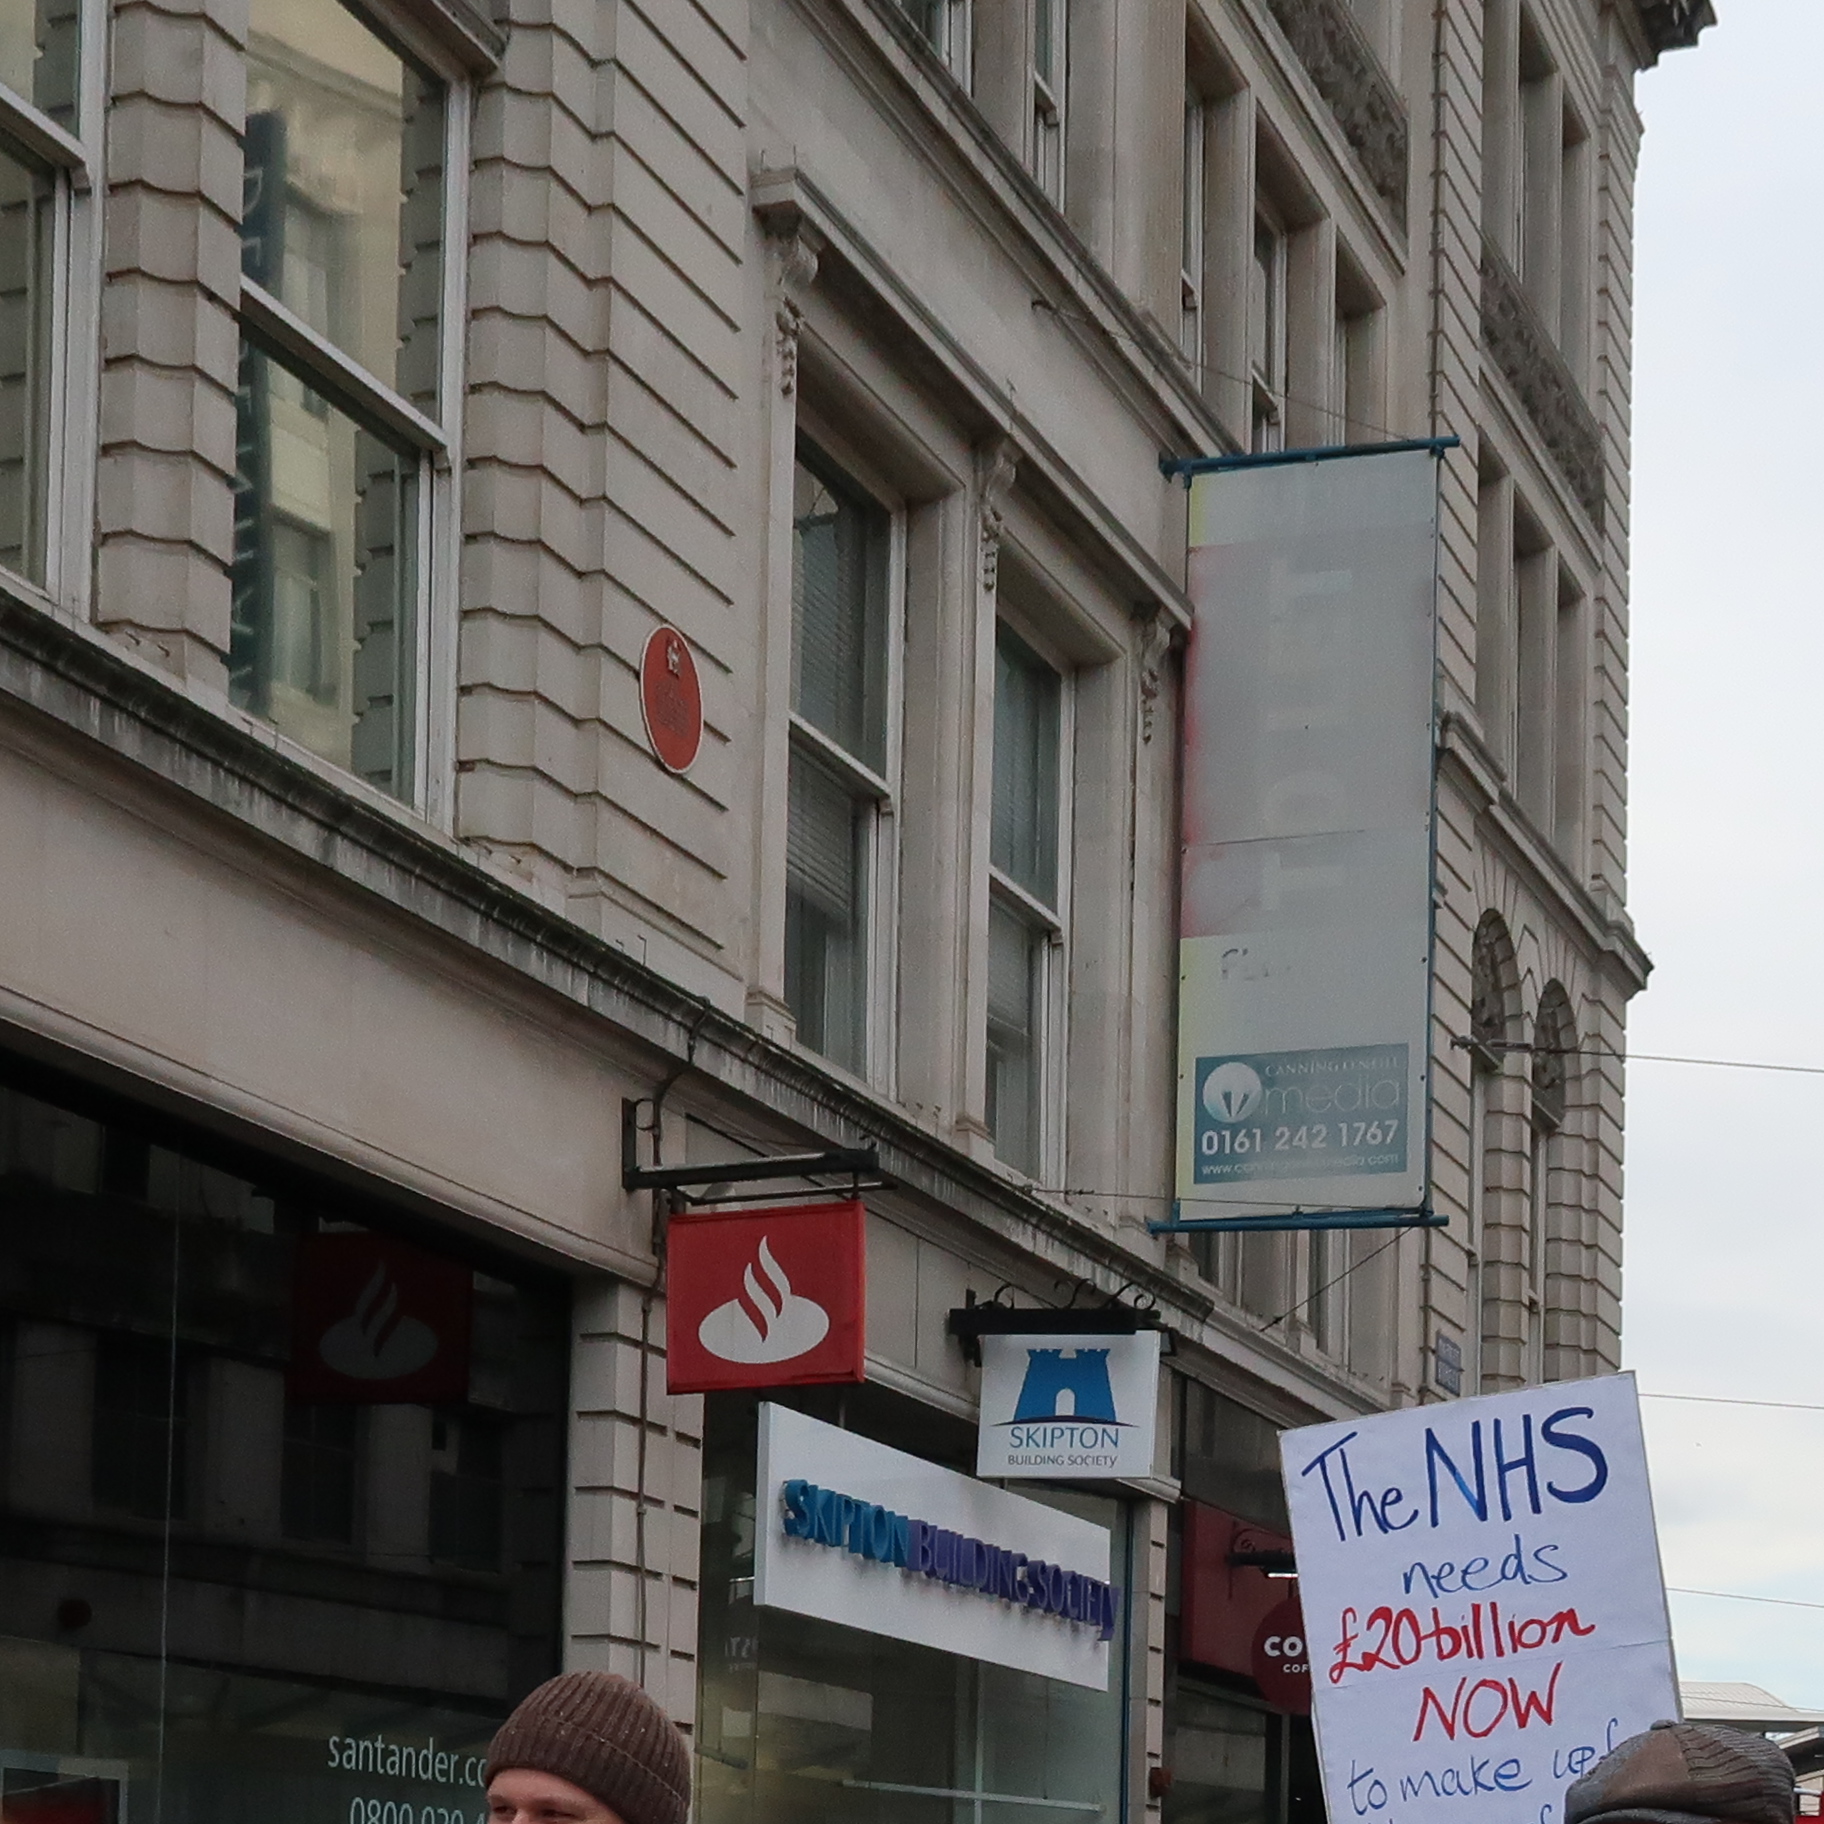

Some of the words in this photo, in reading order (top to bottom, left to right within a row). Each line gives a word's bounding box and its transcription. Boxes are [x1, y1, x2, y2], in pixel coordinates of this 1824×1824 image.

[1263, 1073, 1400, 1116] media
[1201, 1128, 1262, 1155] 0161
[1274, 1123, 1327, 1150] 242
[1337, 1118, 1400, 1148] 1767
[1008, 1425, 1120, 1450] SKIPTON
[1007, 1454, 1065, 1466] BUILDING
[1067, 1454, 1119, 1469] SOCIETY
[1300, 1431, 1420, 1542] The
[1424, 1405, 1610, 1529] NHS
[1402, 1533, 1569, 1600] needs
[1263, 1635, 1303, 1657] CO
[1412, 1661, 1564, 1743] NOW
[1347, 1759, 1385, 1817] to
[1399, 1755, 1535, 1799] make
